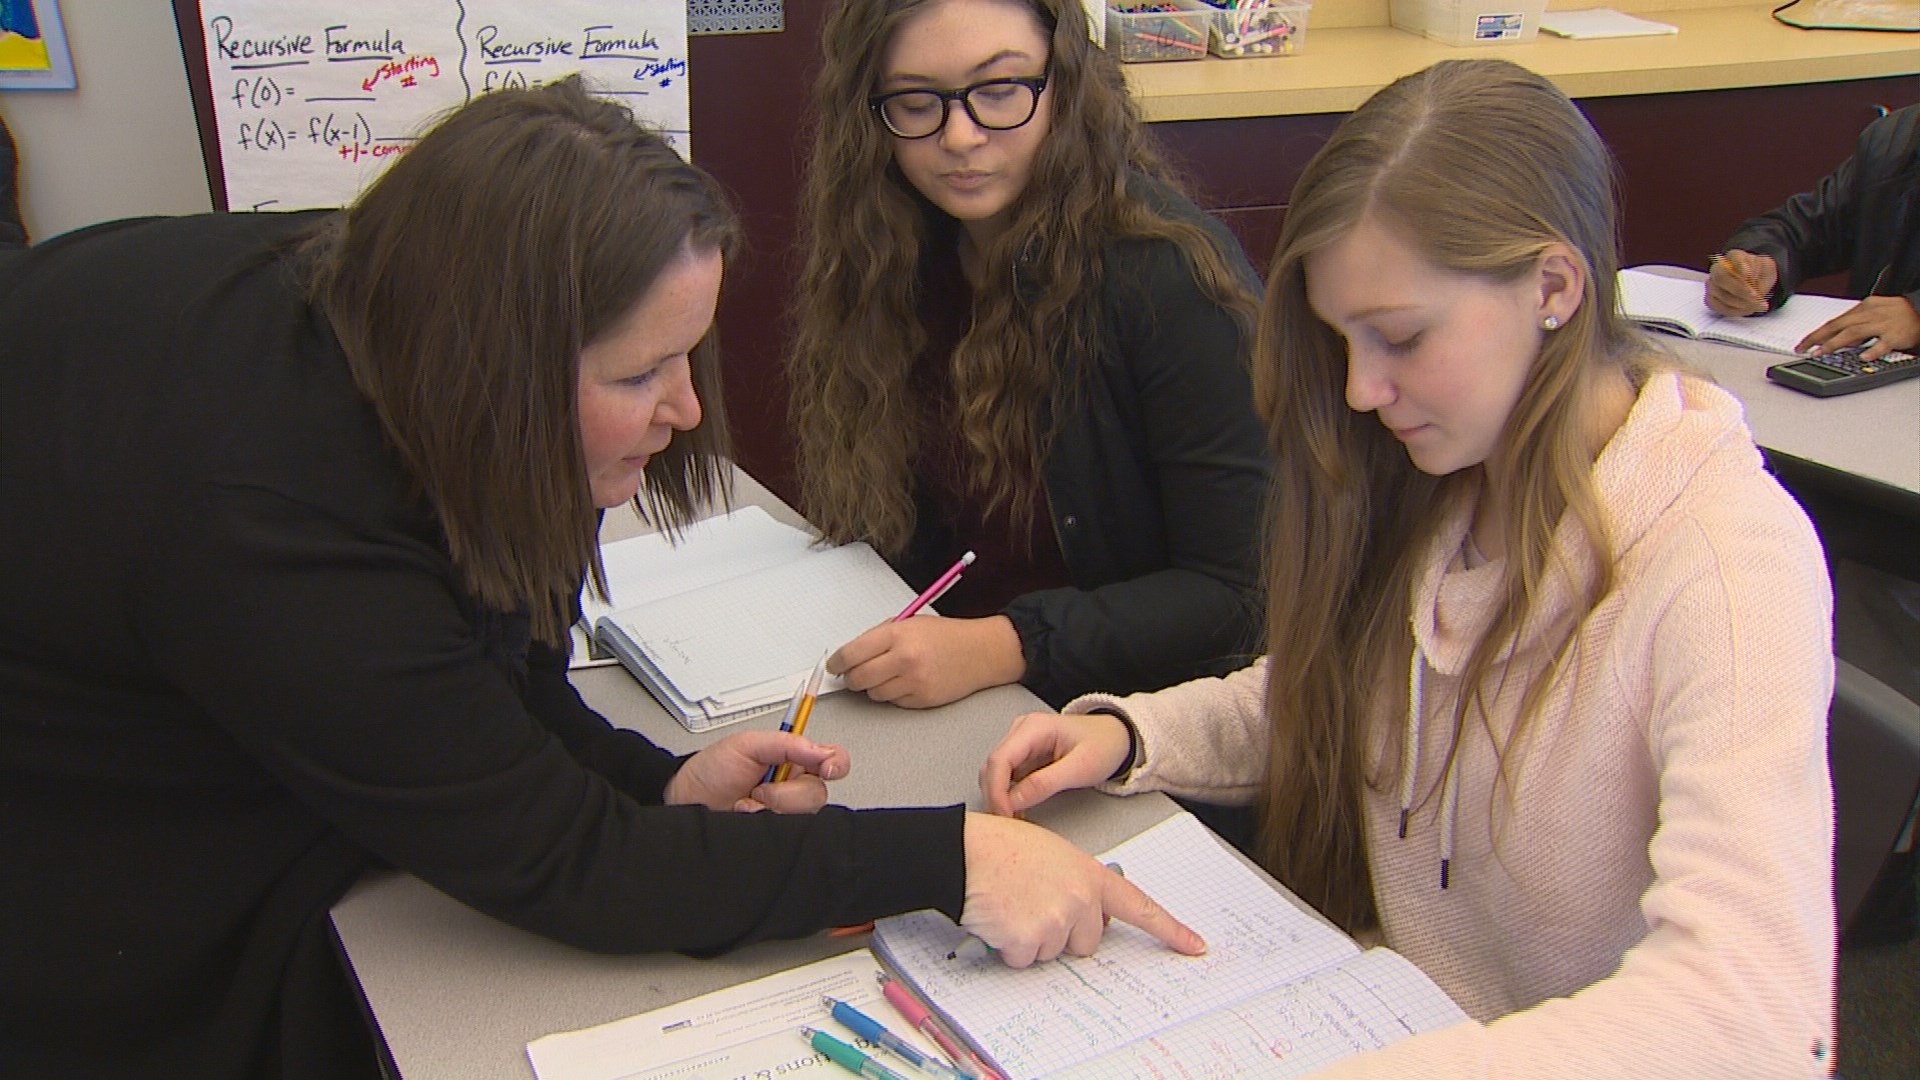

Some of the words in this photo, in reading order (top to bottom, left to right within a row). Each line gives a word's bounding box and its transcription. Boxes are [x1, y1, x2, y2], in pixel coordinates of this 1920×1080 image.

[211, 16, 314, 60] Recursive
[325, 25, 405, 57] Formula
[476, 26, 574, 58] Recursive
[583, 25, 659, 57] Formula
[381, 55, 440, 79] starting
